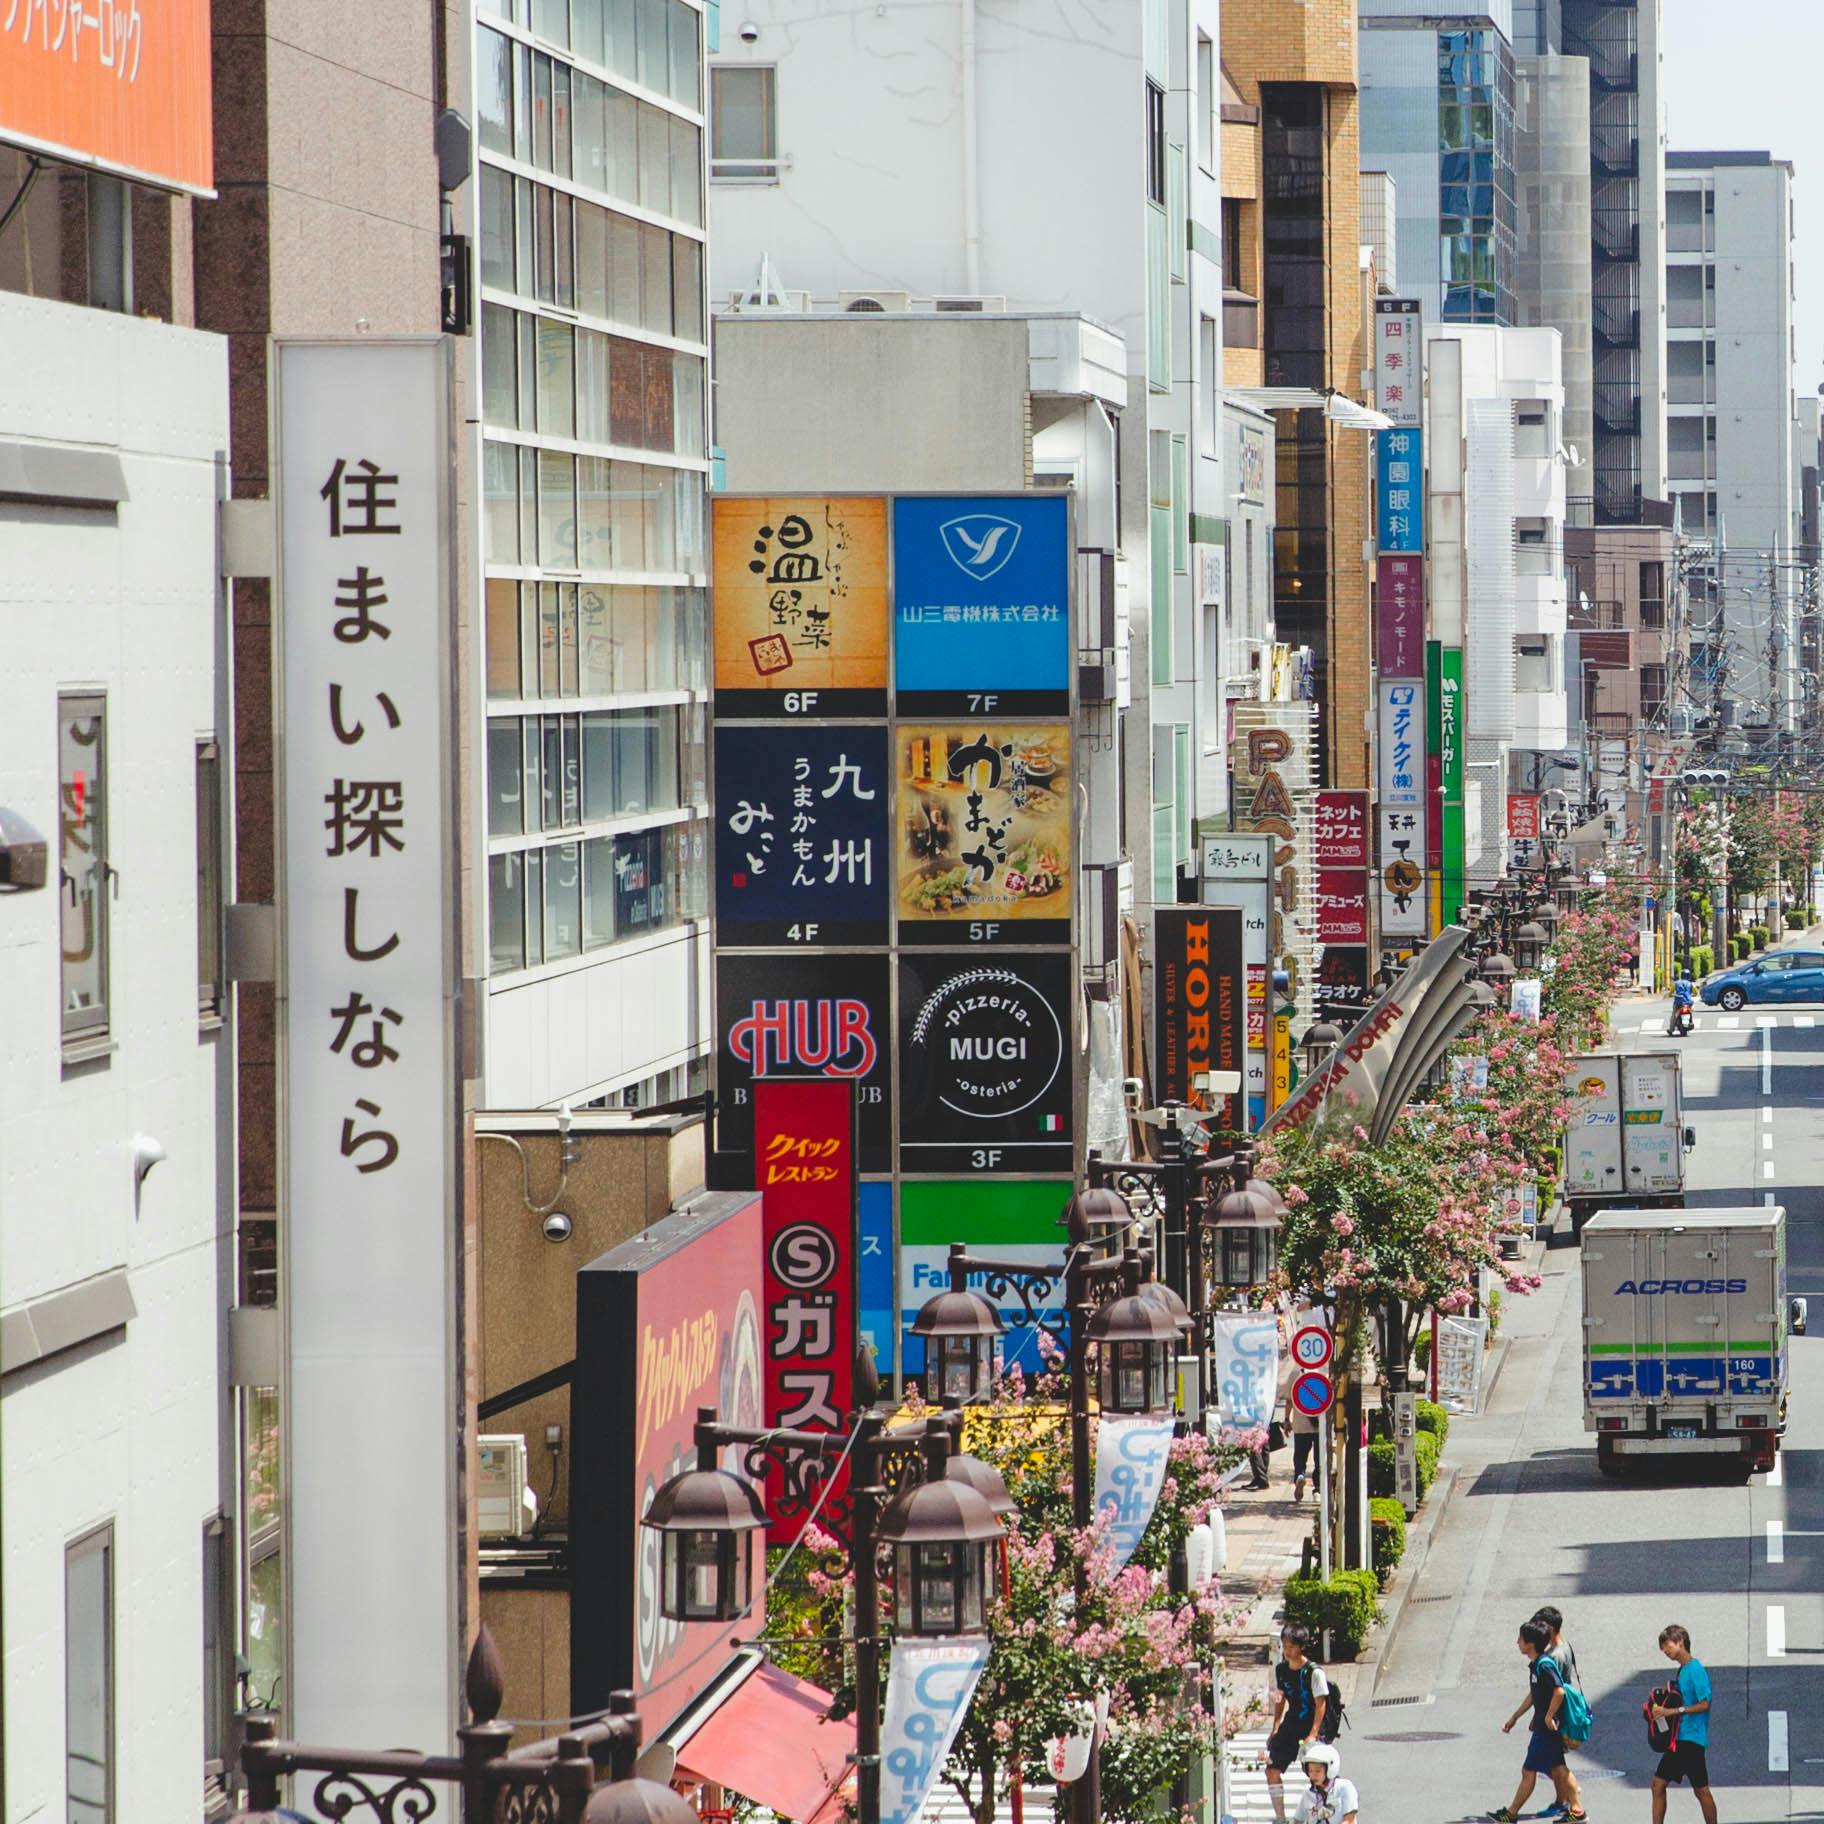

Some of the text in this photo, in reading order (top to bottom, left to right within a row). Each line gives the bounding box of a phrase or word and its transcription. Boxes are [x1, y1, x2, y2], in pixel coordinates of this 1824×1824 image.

[1385, 322, 1403, 401] 四季楽
[748, 514, 833, 649] 温野菜
[902, 605, 1060, 624] 山三電機株式会社
[783, 693, 817, 713] 6F
[967, 694, 999, 713] 7F
[320, 457, 406, 1175] 住まい探しなら
[789, 756, 816, 888] うまかもん
[821, 753, 875, 887] 九州
[728, 798, 775, 876] みこと
[786, 922, 819, 942] 4F
[968, 922, 1000, 941] 5F
[728, 998, 878, 1077] HUB
[949, 1036, 1027, 1063] MUGI
[766, 1133, 841, 1161] クイック
[972, 1149, 1002, 1169] 3F
[766, 1164, 839, 1185] レストラン
[1613, 1278, 1748, 1296] ACROSS
[1733, 1359, 1755, 1370] 160
